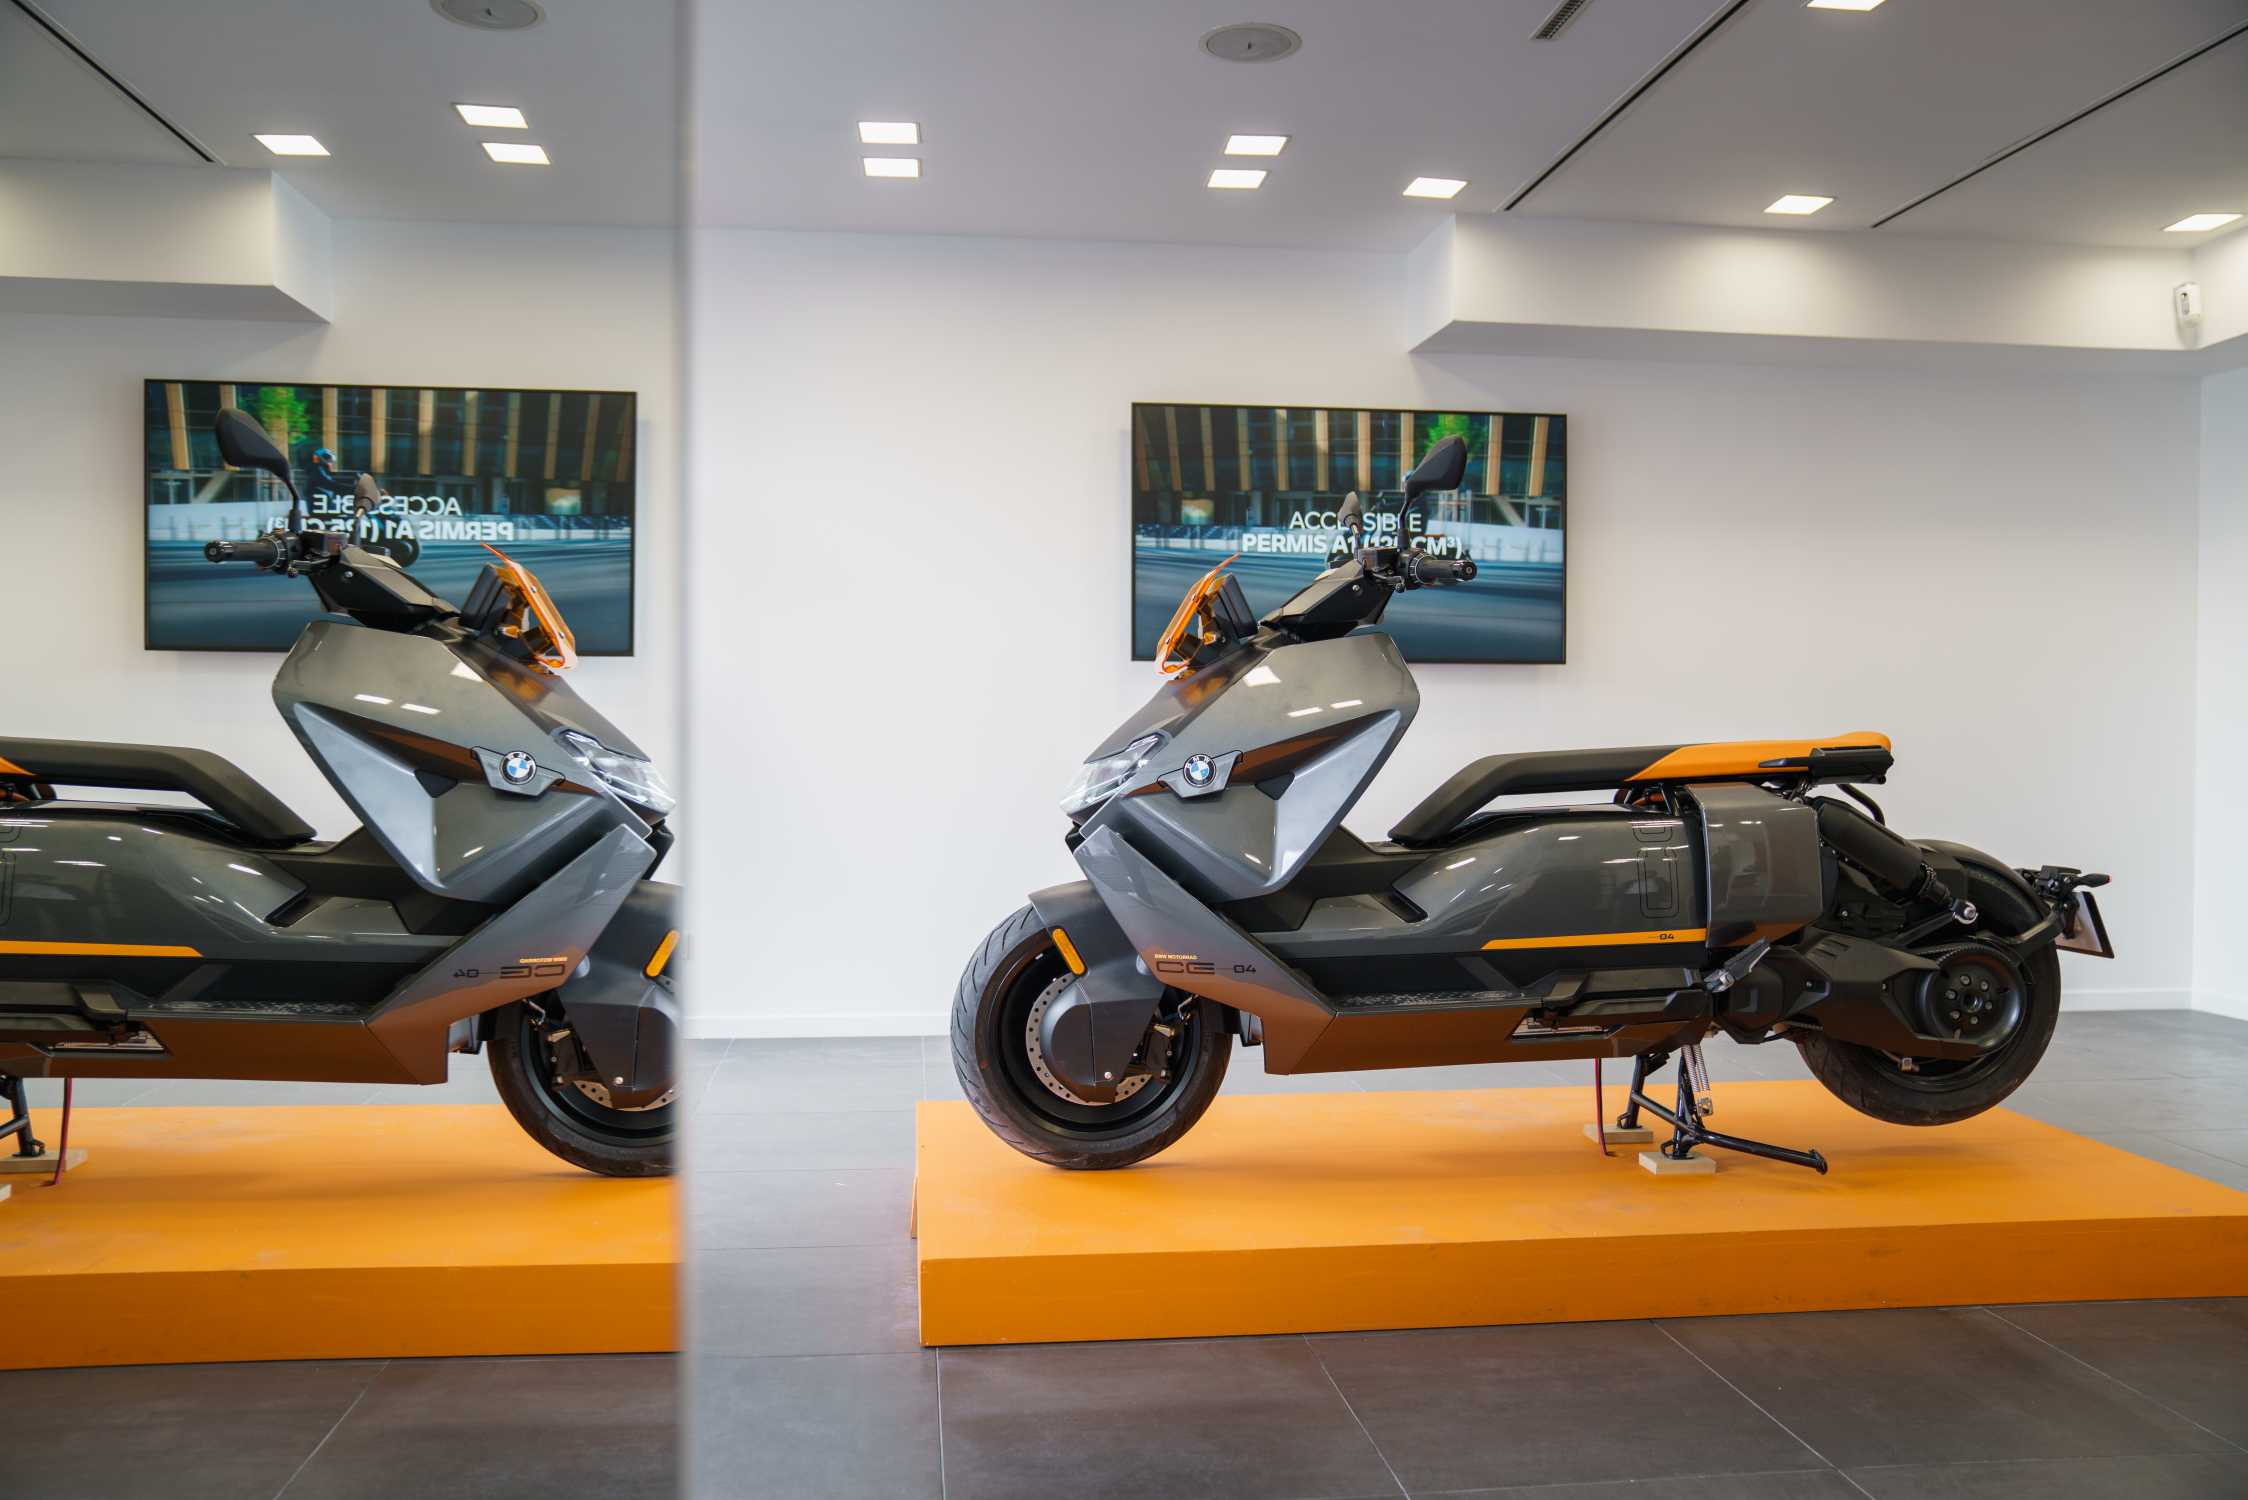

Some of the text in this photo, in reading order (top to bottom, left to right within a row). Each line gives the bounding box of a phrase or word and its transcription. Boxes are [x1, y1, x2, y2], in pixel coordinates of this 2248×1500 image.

[1242, 533, 1328, 553] PERMIS
[1331, 534, 1356, 554] A1
[1233, 964, 1257, 974] 04
